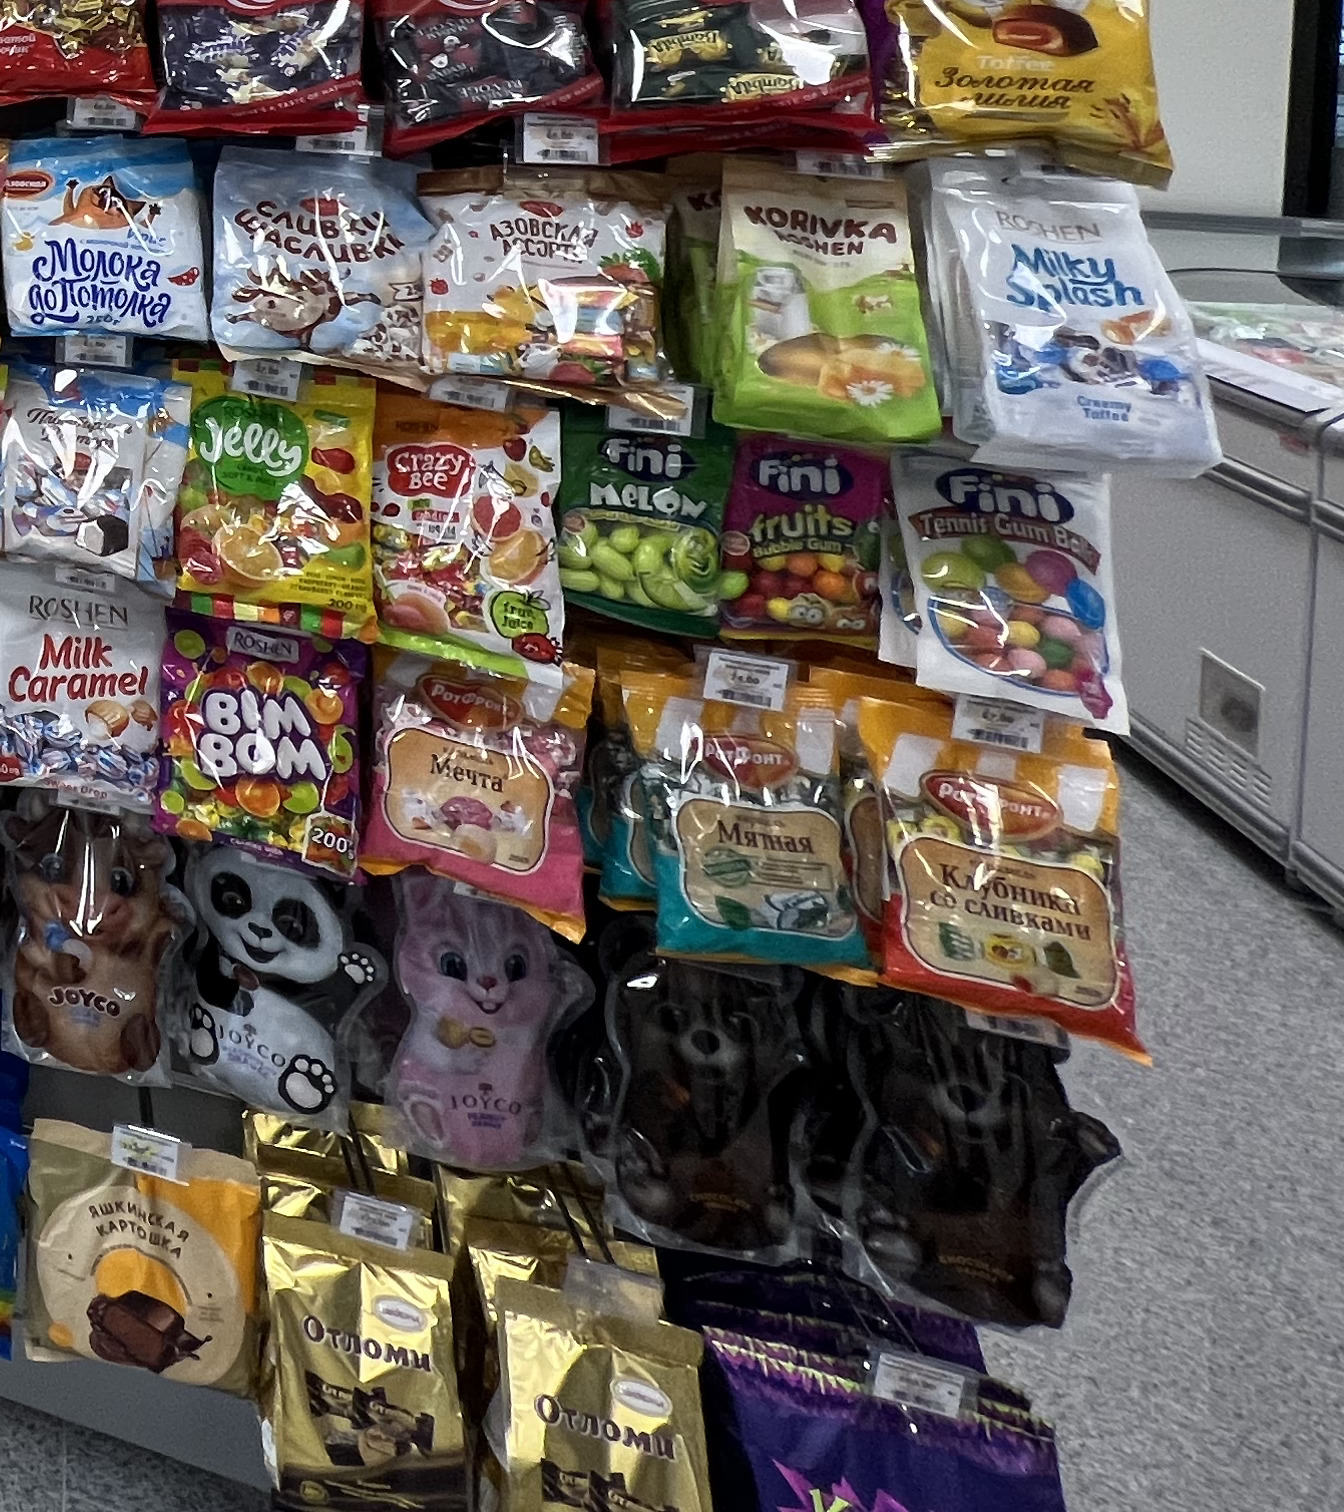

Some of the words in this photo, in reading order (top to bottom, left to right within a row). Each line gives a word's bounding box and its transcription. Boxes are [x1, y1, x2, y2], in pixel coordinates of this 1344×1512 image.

[935, 67, 1096, 94] Золотая
[743, 205, 898, 245] KORIVKA
[778, 230, 864, 256] ROSHEN
[995, 211, 1104, 243] ROSHEN
[32, 238, 162, 292] Молока
[1011, 244, 1116, 287] Milky
[1006, 273, 1145, 313] Splash
[1076, 394, 1133, 413] Creamy
[1083, 408, 1130, 423] Toffee
[200, 416, 302, 477] Jelly
[395, 451, 467, 476] Crazy
[607, 438, 683, 479] Fini
[758, 457, 841, 496] Fini
[949, 473, 1068, 524] Fini
[749, 506, 852, 544] fruits
[921, 514, 993, 538] Tennis
[998, 517, 1047, 544] Gum
[753, 539, 803, 558] Bubble
[806, 536, 843, 554] Gum
[29, 594, 129, 626] ROSHEN
[40, 633, 114, 670] Milk
[232, 631, 293, 658] ROSHEN
[8, 666, 149, 703] Caramel
[205, 689, 313, 742] BIM
[199, 733, 328, 781] BOM
[430, 753, 505, 794] Мечта
[717, 819, 814, 855] Мятная
[940, 861, 1082, 917] Клубника
[928, 889, 960, 910] со
[963, 898, 1093, 942] сливками
[47, 986, 122, 1018] JOYCO
[218, 1023, 287, 1069] JOYCO
[451, 1094, 522, 1116] JOYCO
[88, 1202, 191, 1244] ЯШКИНСКАЯ
[95, 1221, 183, 1260] КАРТОШКА
[303, 1313, 433, 1373] Отломи
[534, 1392, 678, 1462] Отломи
